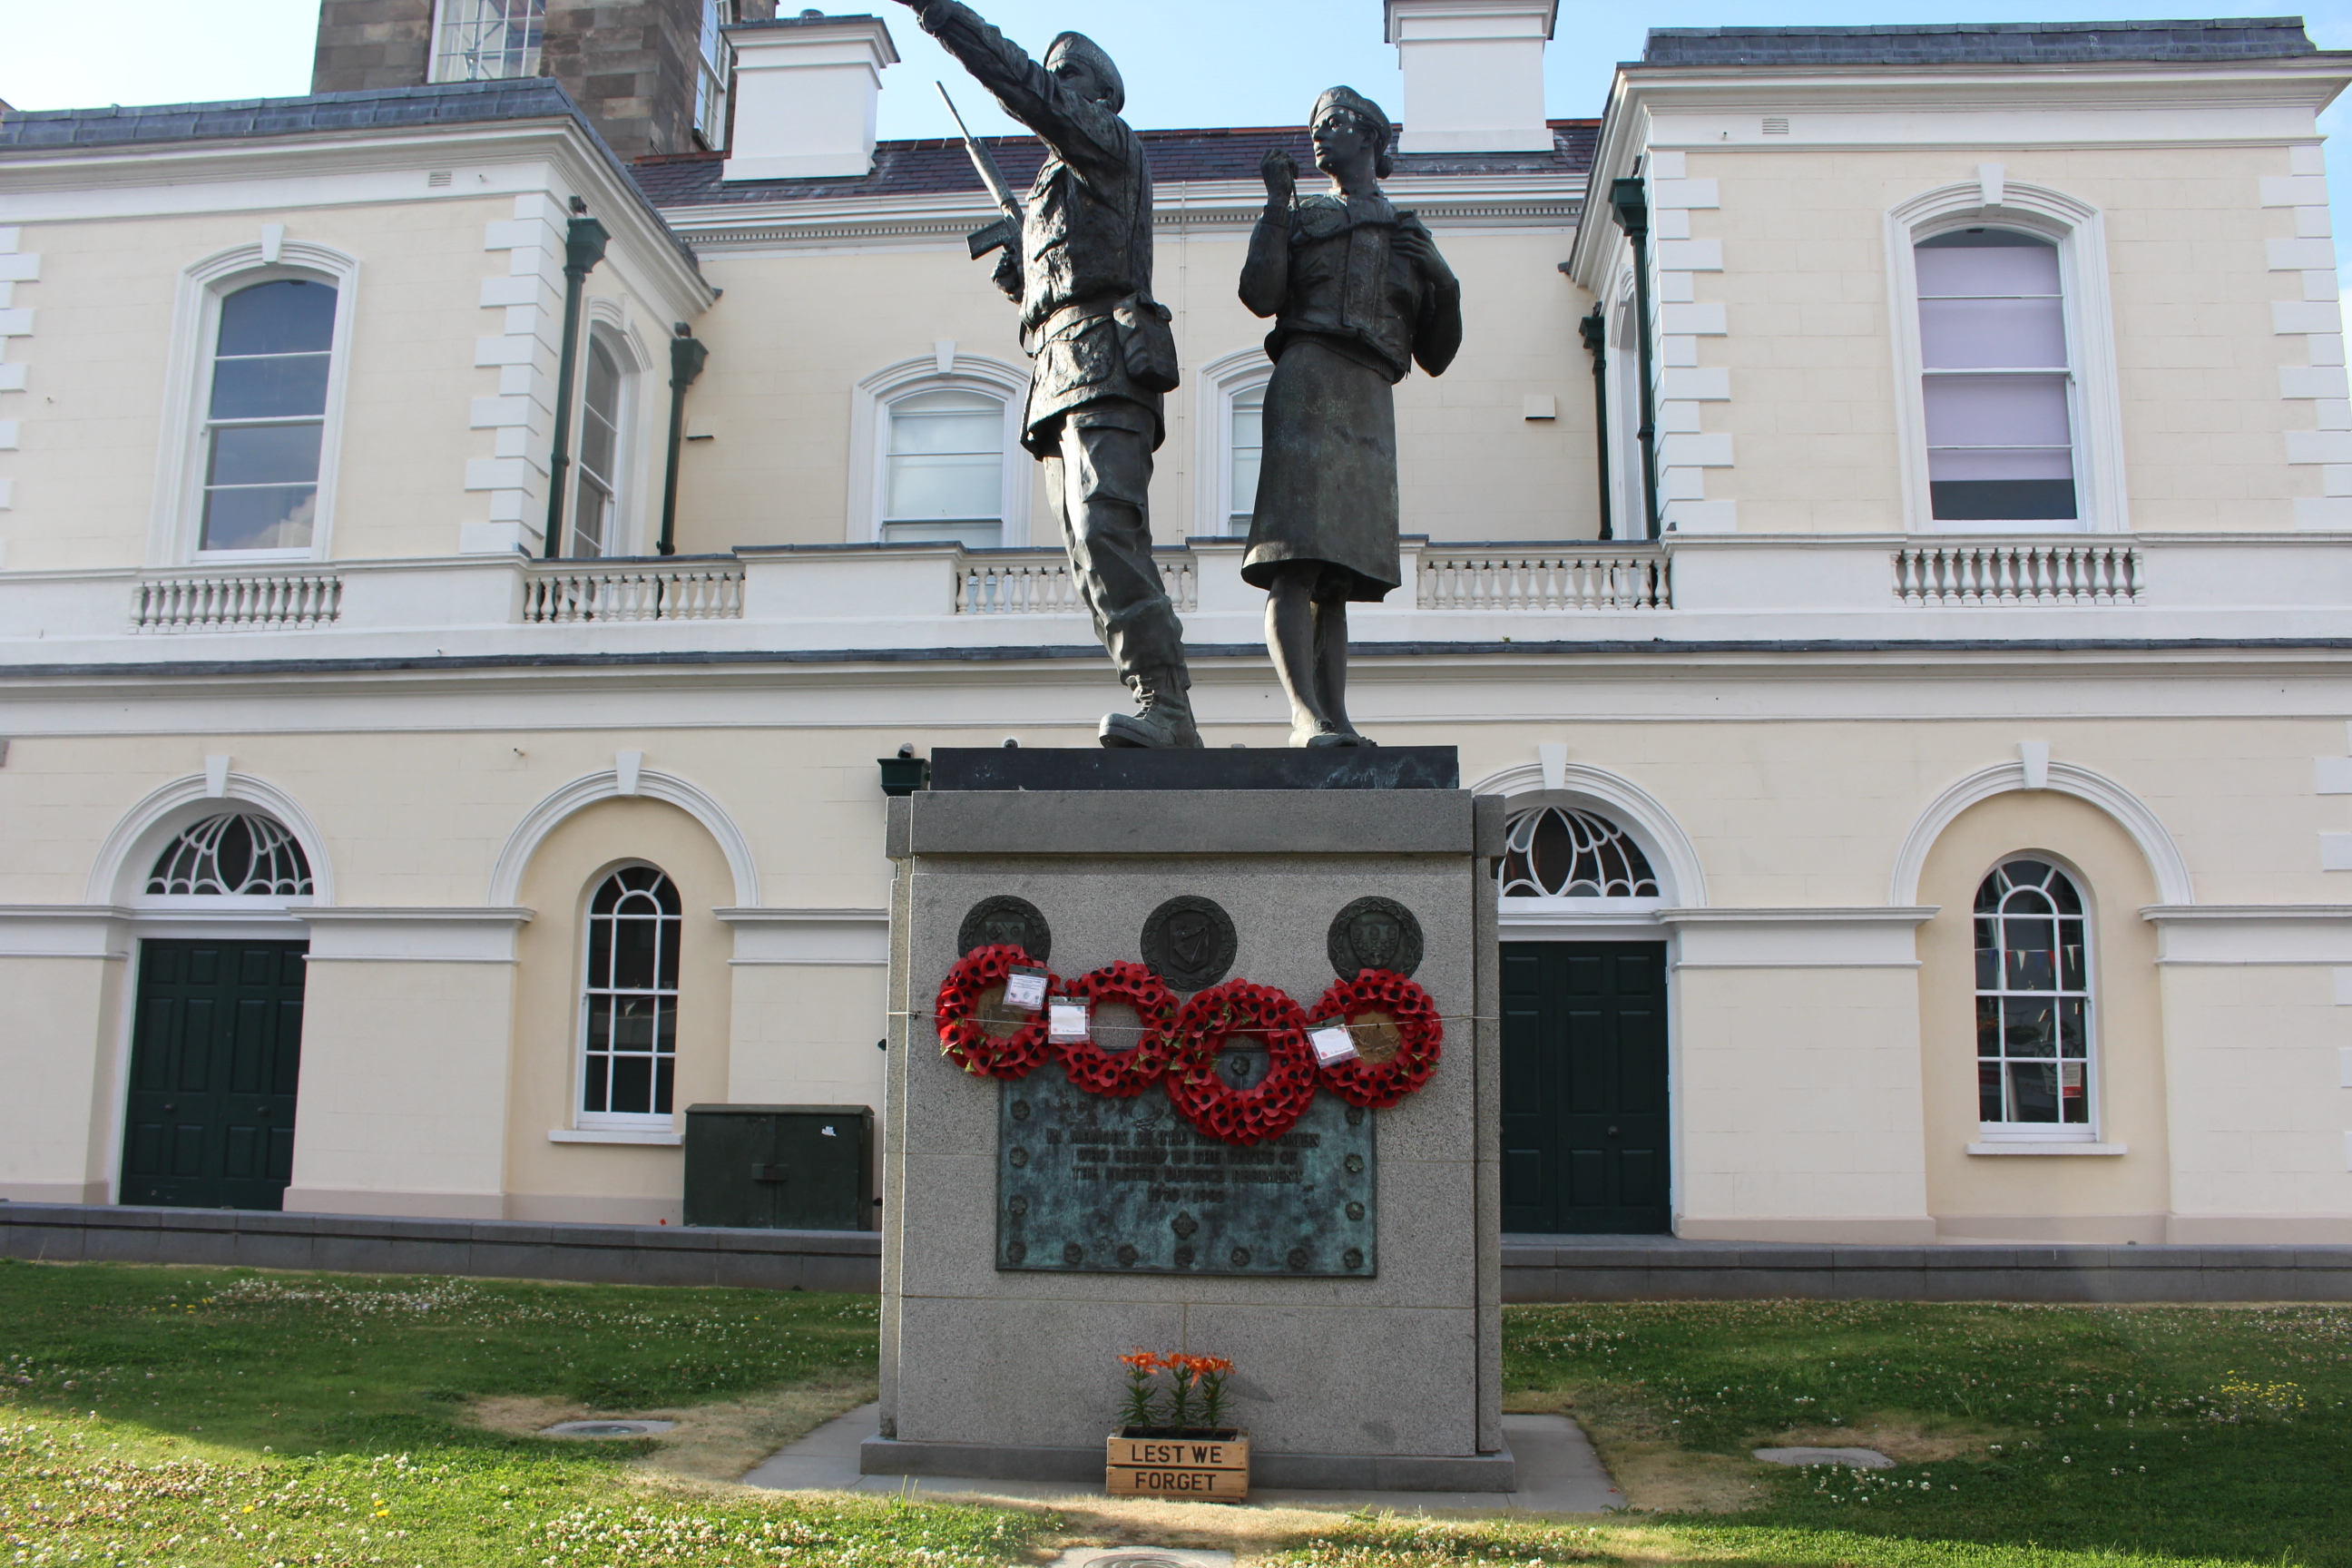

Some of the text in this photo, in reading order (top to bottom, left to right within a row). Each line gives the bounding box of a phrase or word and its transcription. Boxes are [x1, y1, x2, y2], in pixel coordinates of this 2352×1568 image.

[1046, 1128, 1062, 1143] IN
[1070, 1130, 1128, 1144] MEMORY
[1135, 1131, 1152, 1145] OF
[1159, 1131, 1188, 1146] THE
[1077, 1147, 1298, 1165] WHO SERVED IN THE RANKS OF
[1072, 1166, 1304, 1183] THE ULSTER DEFENCE REGIMENT
[1132, 1445, 1222, 1464] LEST WE
[1135, 1472, 1217, 1491] FORGET
